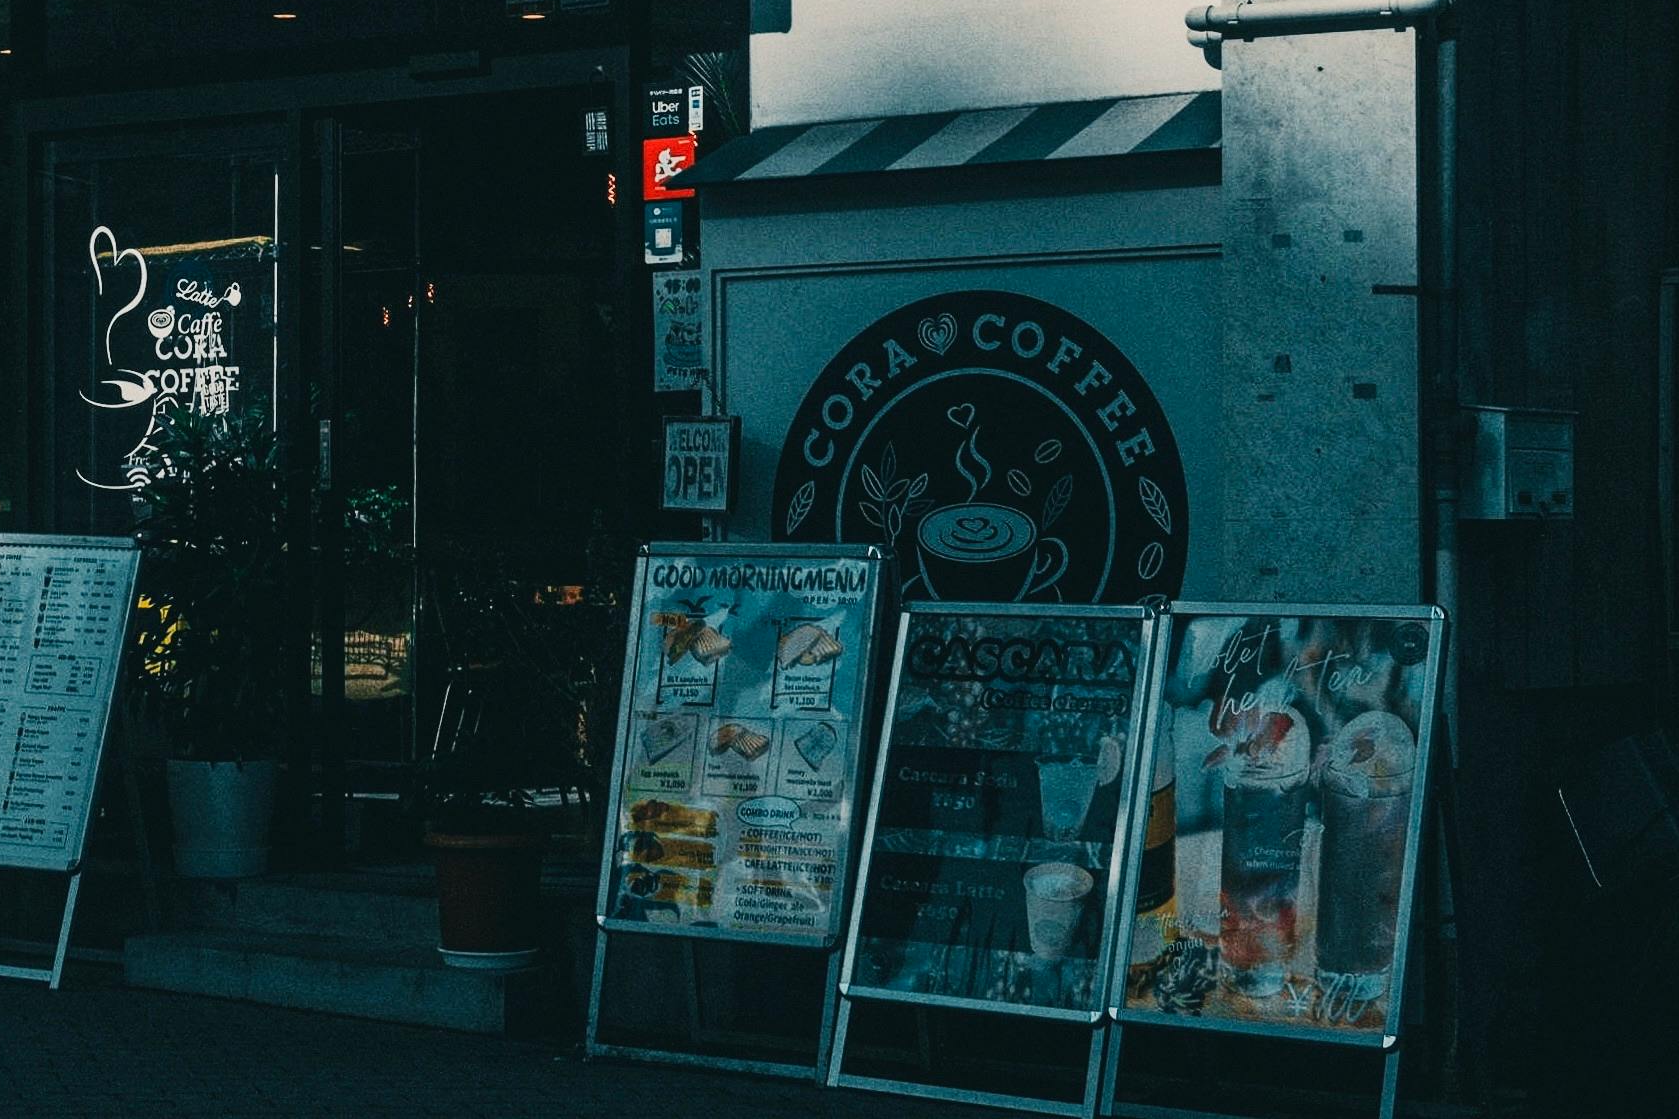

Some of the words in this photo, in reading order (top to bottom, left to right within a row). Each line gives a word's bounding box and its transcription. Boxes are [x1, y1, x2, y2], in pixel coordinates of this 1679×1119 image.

[652, 101, 679, 113] Uber
[652, 114, 680, 127] Eats
[176, 279, 221, 308] Latte
[155, 334, 227, 360] CORA
[144, 367, 240, 393] COFFEE
[804, 339, 918, 466] CORA
[972, 314, 1155, 466] COFFEE
[653, 564, 706, 589] GOOD
[708, 564, 803, 592] MORNING
[803, 567, 866, 593] MENU
[803, 596, 828, 604] OPEN
[909, 637, 1134, 683] CASCARA
[770, 809, 795, 818] DRINK
